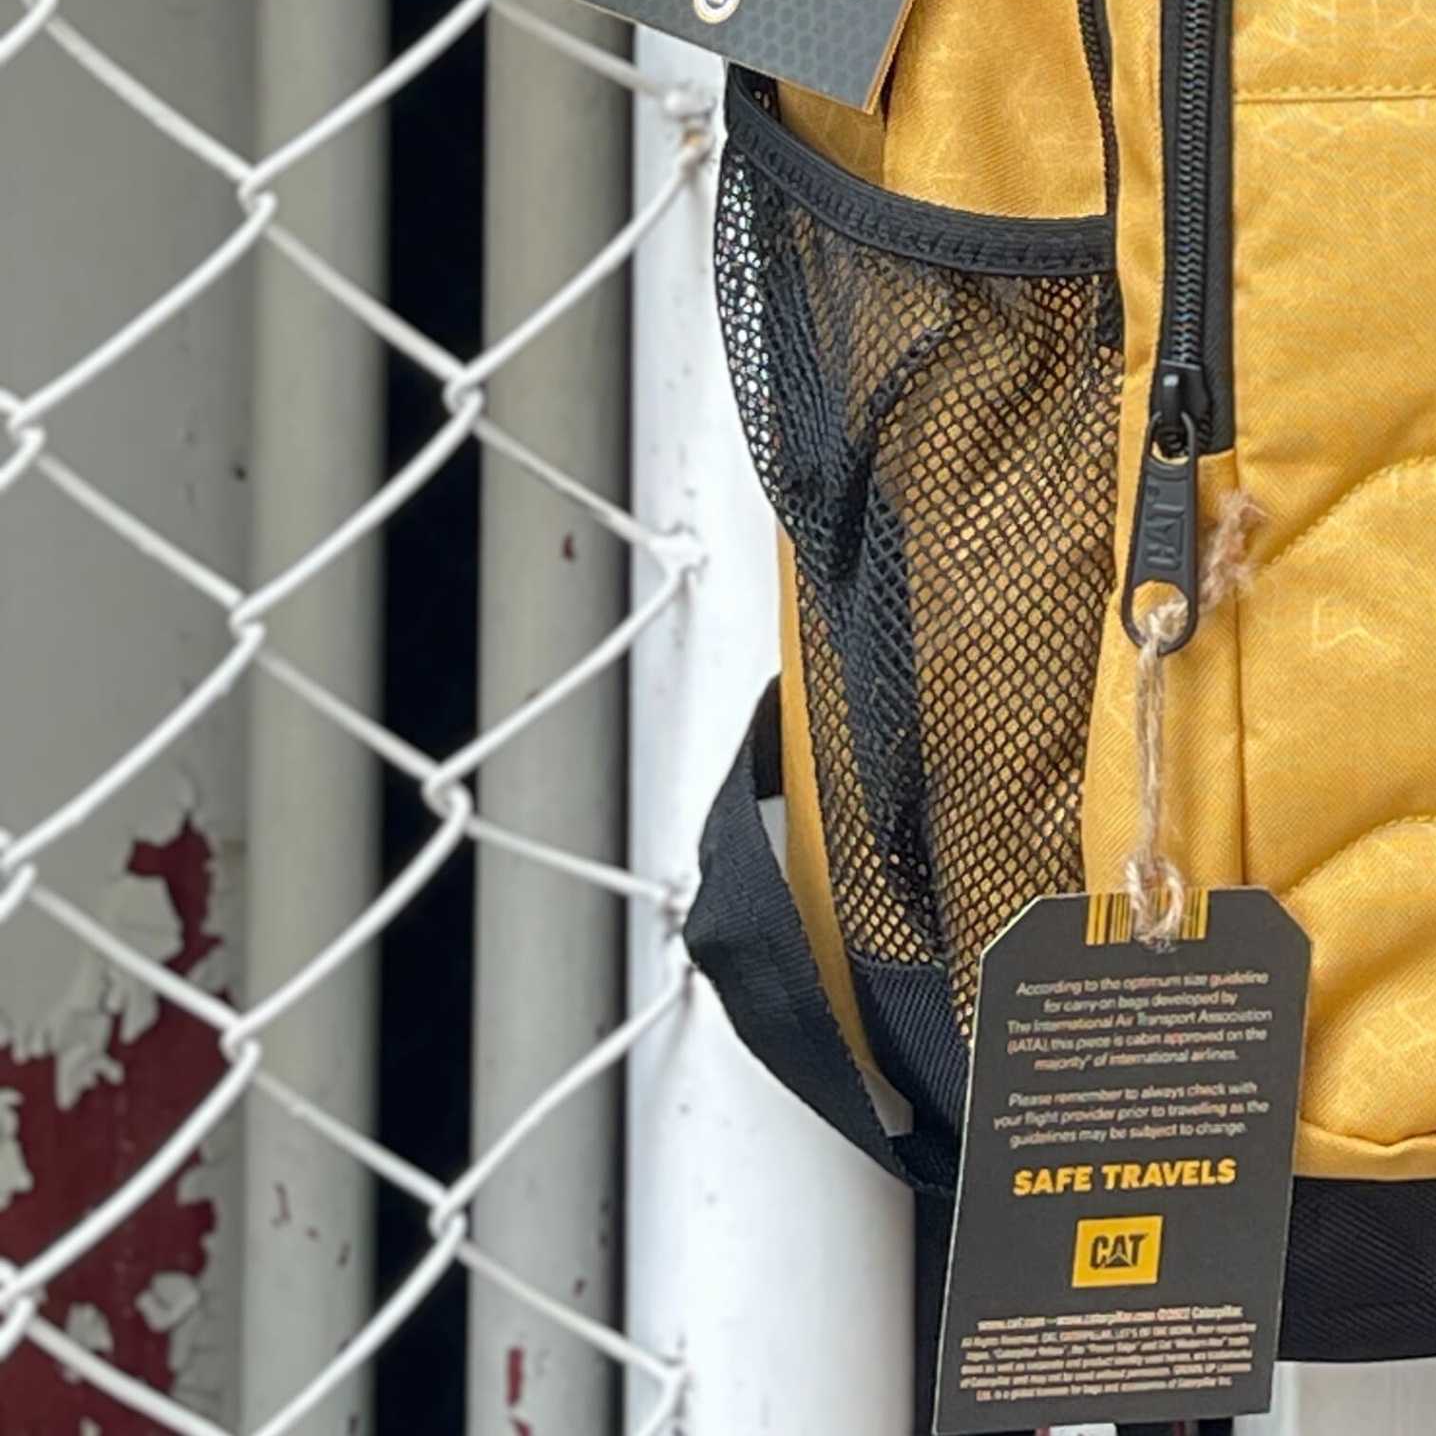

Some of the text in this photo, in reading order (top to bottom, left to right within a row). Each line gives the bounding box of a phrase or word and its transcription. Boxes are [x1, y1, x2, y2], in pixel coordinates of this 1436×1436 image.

[1015, 979, 1083, 997] According
[1083, 979, 1100, 992] to
[1099, 977, 1122, 991] the
[1043, 998, 1063, 1013] for
[1117, 995, 1151, 1011] bags
[1150, 990, 1220, 1008] developed
[1220, 990, 1238, 1006] by
[1007, 1019, 1033, 1034] The
[1162, 1028, 1225, 1046] approved
[1226, 1030, 1244, 1042] on
[1244, 1027, 1268, 1041] the
[1124, 1088, 1139, 1101] to
[993, 1114, 1023, 1130] your
[1060, 1107, 1116, 1125] provider
[1150, 1105, 1166, 1118] to
[1246, 1099, 1270, 1113] the
[1078, 1129, 1108, 1143] may
[1109, 1126, 1127, 1140] be
[1129, 1123, 1178, 1140] subject
[1179, 1123, 1195, 1136] to
[1012, 1158, 1237, 1196] SAFE TRAVELS
[1090, 1232, 1149, 1270] CAT
